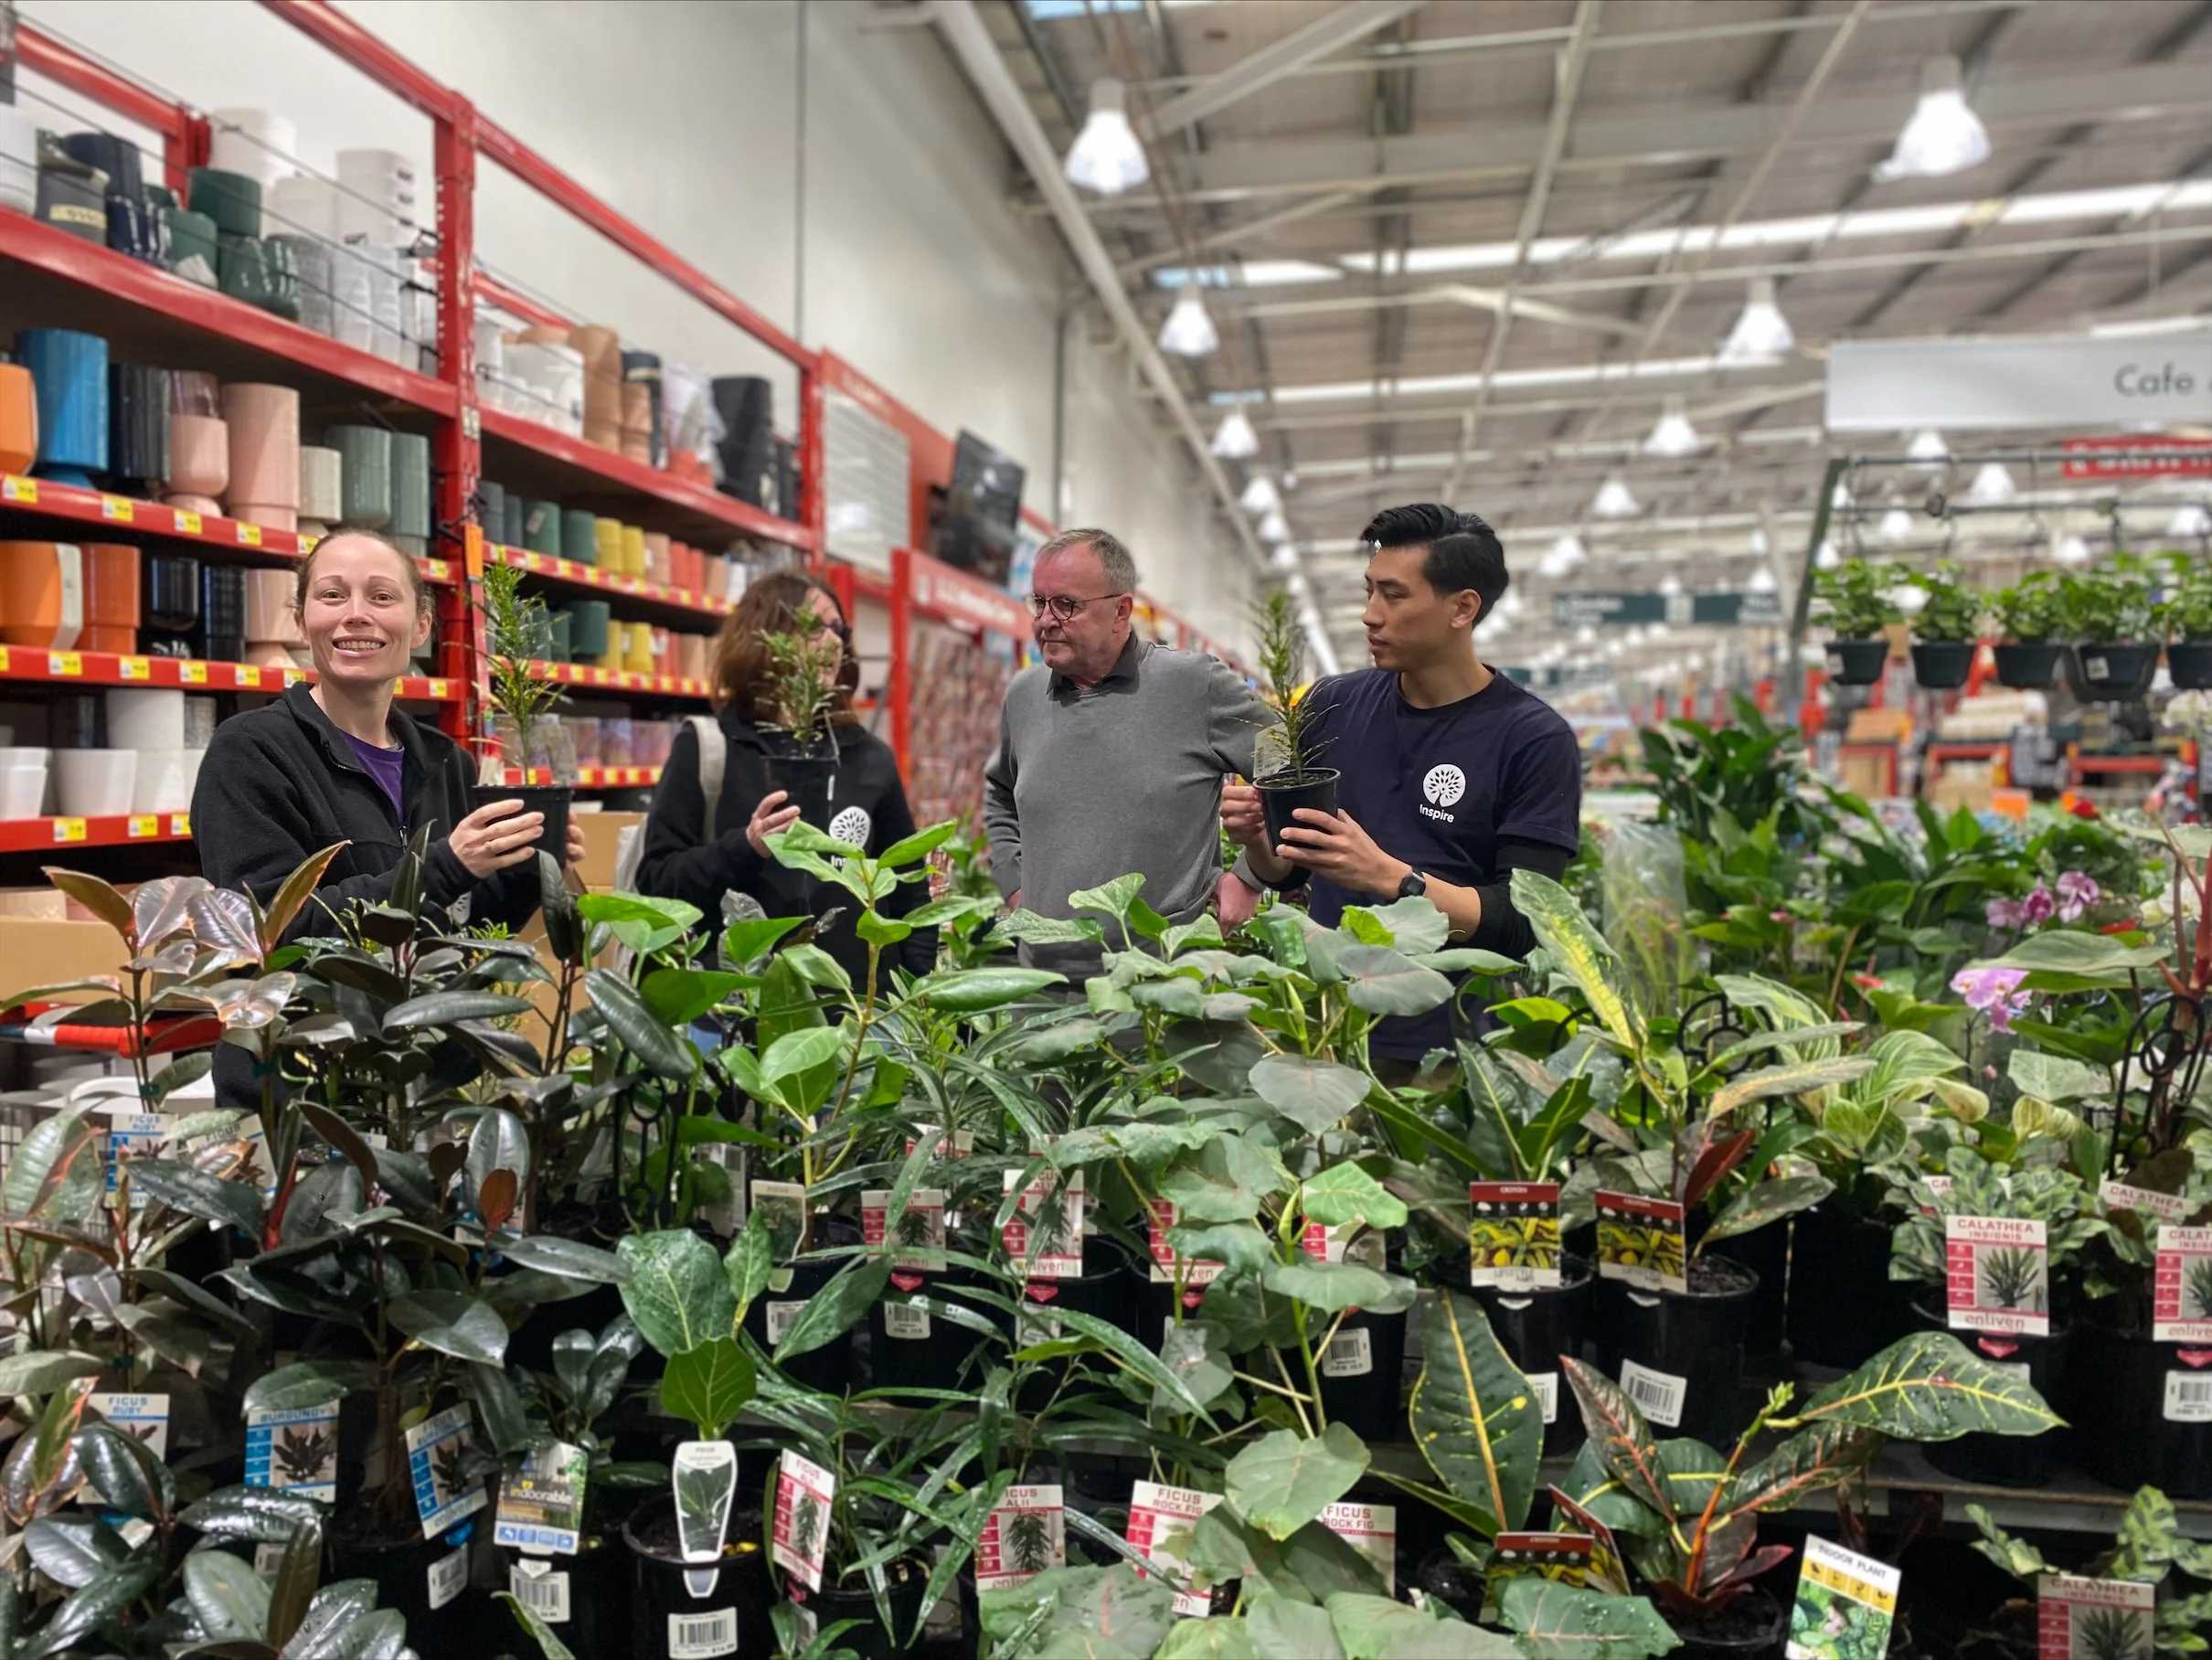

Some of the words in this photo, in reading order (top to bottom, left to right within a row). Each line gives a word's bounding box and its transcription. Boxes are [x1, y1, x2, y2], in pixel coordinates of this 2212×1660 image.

[2112, 361, 2196, 397] Cafe
[1420, 803, 1454, 823] Inspire
[129, 1115, 160, 1123] FICUS
[206, 1123, 241, 1142] FICUS
[2110, 1186, 2183, 1209] CALATHEA
[1957, 1219, 2034, 1233] CALATHEA
[1969, 1231, 2022, 1241] INSIGNIS
[1965, 1314, 2025, 1328] enliven
[109, 1397, 147, 1406] FICUS
[112, 1406, 141, 1414] RUBY
[261, 1409, 324, 1421] BURGUNDY
[796, 1459, 821, 1489] FICUS
[510, 1483, 573, 1506] indoorable
[1005, 1488, 1038, 1497] ICUS
[1157, 1487, 1201, 1505] FICUS
[1006, 1499, 1029, 1507] ALII
[1153, 1498, 1183, 1511] ROCK
[1186, 1505, 1203, 1516] FIG
[1326, 1506, 1371, 1519] FICUS
[1324, 1518, 1354, 1529] ROCK
[1356, 1520, 1375, 1530] FIG
[1818, 1545, 1854, 1565] INDOOR
[1856, 1560, 1887, 1579] PLANT
[2051, 1579, 2140, 1596] CALATHEA
[2065, 1591, 2127, 1603] INSIGNIS
